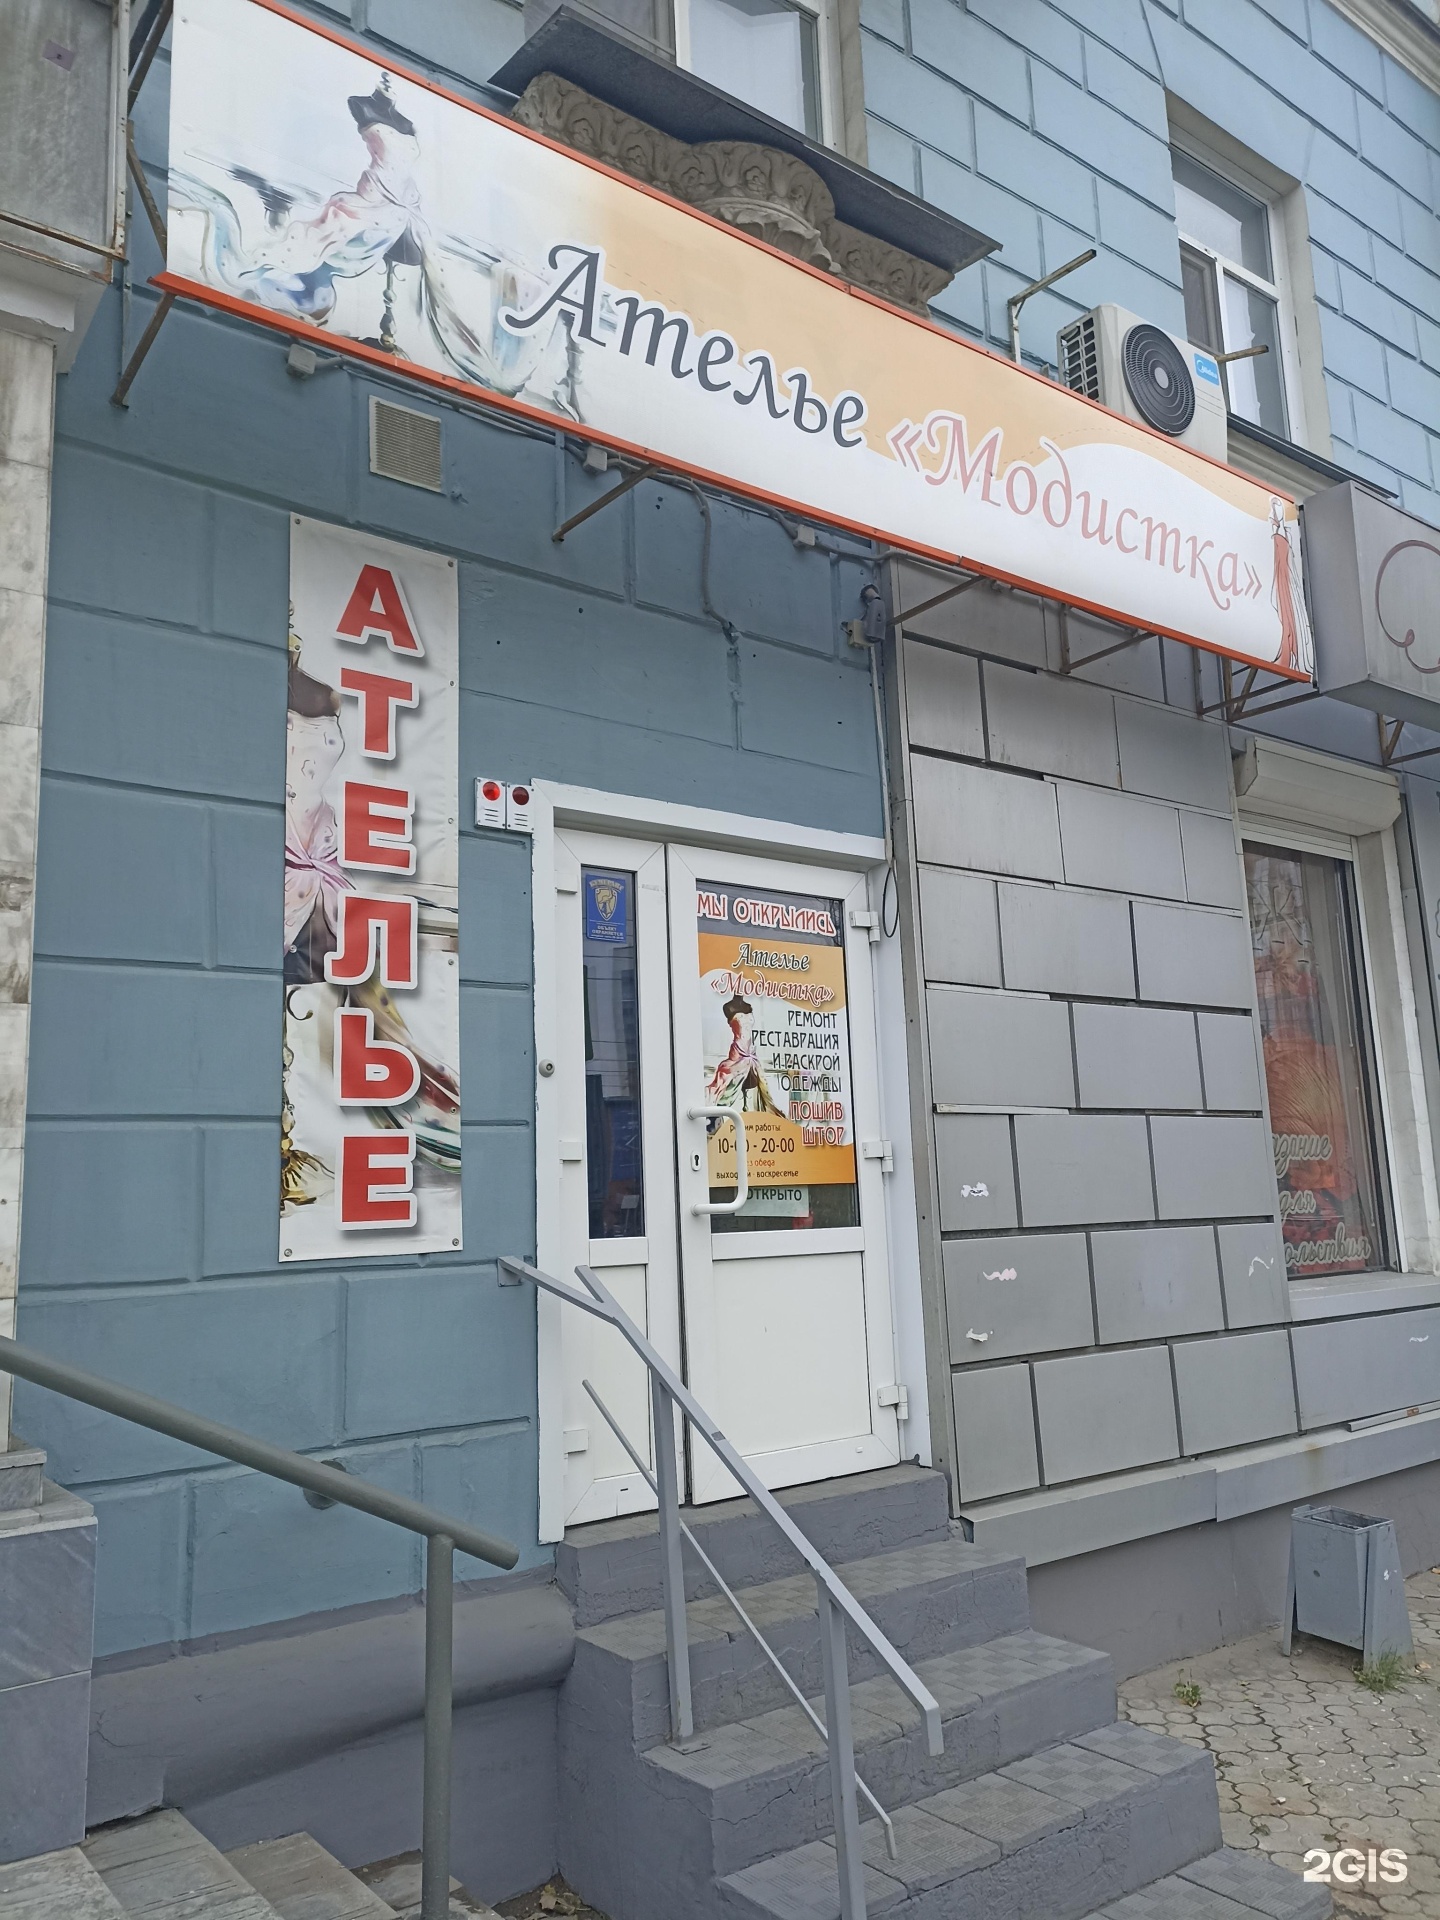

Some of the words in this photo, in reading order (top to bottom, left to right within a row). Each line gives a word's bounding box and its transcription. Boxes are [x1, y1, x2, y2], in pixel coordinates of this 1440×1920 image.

[504, 244, 864, 447] Ателье
[890, 415, 1263, 610] «Модистка»
[331, 562, 420, 1224] АТЕЛЬЕ
[696, 893, 727, 918] МЫ
[735, 899, 836, 935] ОТКРЫЛИСЬ
[732, 943, 810, 970] Ателье
[710, 971, 835, 1007] «Модистка»
[788, 1010, 837, 1029] РЕМОНТ
[752, 1030, 840, 1049] РЕСТАВРАЦИЯ
[773, 1053, 781, 1069] И
[784, 1053, 841, 1071] РАСКРОЙ
[781, 1075, 842, 1092] ОДЕЖДЫ
[790, 1101, 843, 1121] ПОШИВ
[729, 1124, 753, 1132] рим
[803, 1126, 845, 1145] ШТОР
[761, 1138, 795, 1153] 20-00
[754, 1159, 776, 1168] обеда
[756, 1170, 799, 1179] воскресенье
